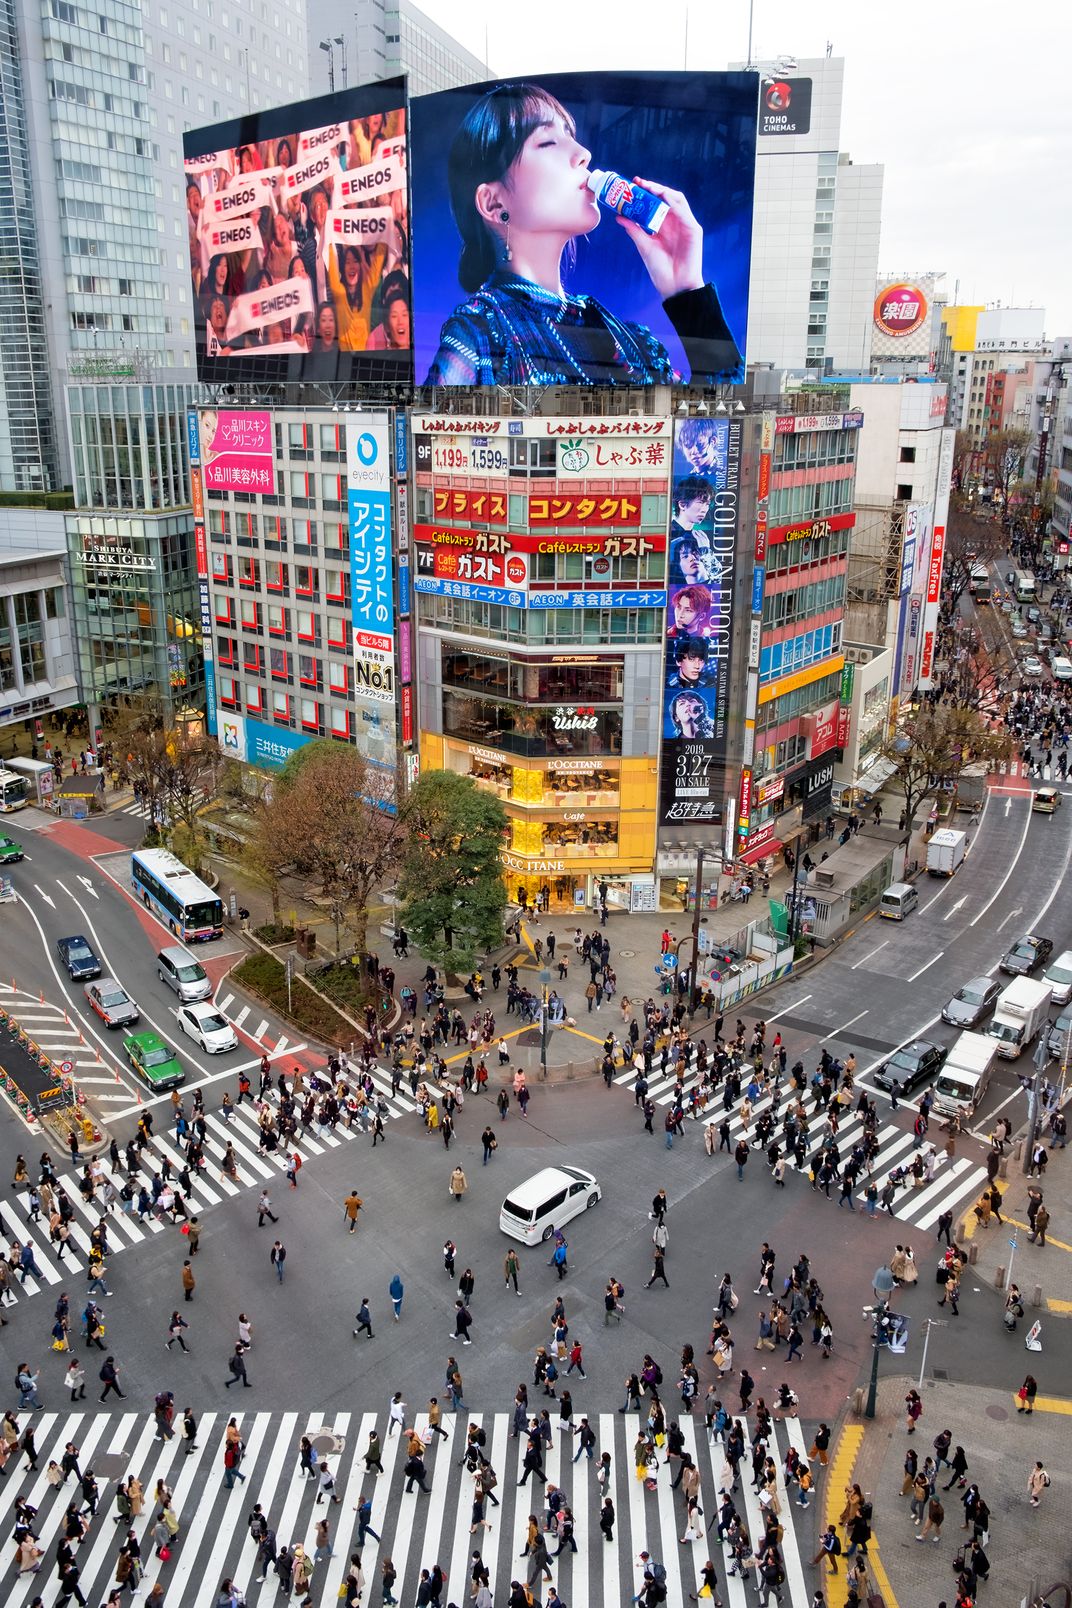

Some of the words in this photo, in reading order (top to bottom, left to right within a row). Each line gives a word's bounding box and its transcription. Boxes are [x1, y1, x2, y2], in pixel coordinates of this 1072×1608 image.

[763, 116, 788, 124] TOHO
[763, 123, 796, 132] CINEMAS
[309, 126, 340, 149] ENEOS
[295, 156, 330, 183] ENEOS
[351, 168, 392, 193] ENEOS
[222, 188, 256, 212] ENEOS
[219, 226, 252, 245] ENEOS
[343, 218, 387, 234] ENEOS
[260, 290, 301, 315] ENEOS
[881, 301, 920, 320] 楽園
[231, 419, 268, 432] 品川スキン
[421, 420, 501, 434] しゃぶしゃぶバイキング
[546, 421, 665, 435] しゃぶしゃぶバイキング
[232, 434, 265, 447] クリニック
[396, 422, 405, 469] 東急リバブル
[716, 423, 728, 450] Arena
[729, 423, 741, 457] BULLET
[418, 445, 431, 458] 9F
[594, 442, 665, 467] しゃぶ葉
[214, 466, 270, 486] 品川美容外科
[352, 469, 384, 485] eyecity
[727, 462, 738, 490] TRAIN
[434, 492, 508, 518] プライス
[529, 498, 638, 521] コンタクト
[711, 491, 737, 582] GOLDEN
[811, 520, 831, 540] ガスト
[94, 544, 133, 554] SHIBUYA
[476, 532, 511, 554] ガスト
[603, 537, 654, 557] ガスト
[757, 532, 765, 555] ガスト
[76, 551, 116, 564] MARK
[122, 555, 156, 566] CITY
[353, 501, 373, 620] アイシティ
[373, 503, 389, 623] コンタクトの
[418, 551, 434, 567] 7F
[438, 553, 456, 565] Café
[458, 553, 501, 581] ガスト
[509, 567, 525, 577] ガスト
[929, 556, 941, 595] TaxFree
[417, 579, 437, 590] AEON
[443, 581, 506, 602] 英会話イーオン
[533, 594, 564, 606] AEON
[572, 593, 664, 606] 英会話イーオン
[707, 588, 732, 659] EPOCH
[360, 634, 390, 650] 当ビル5階
[720, 661, 727, 669] AT
[355, 659, 394, 693] No.1
[718, 671, 726, 698] SAITAMA
[356, 686, 393, 701] コンタクトショップ
[717, 699, 725, 718] SUPER
[552, 715, 598, 730] Ushi8
[468, 745, 507, 763] L'OCCITANE
[547, 760, 603, 769] L'OCCITANE
[676, 755, 713, 777] 3.27
[675, 777, 687, 787] ON
[688, 776, 710, 787] SALE
[808, 765, 833, 793] LUSH
